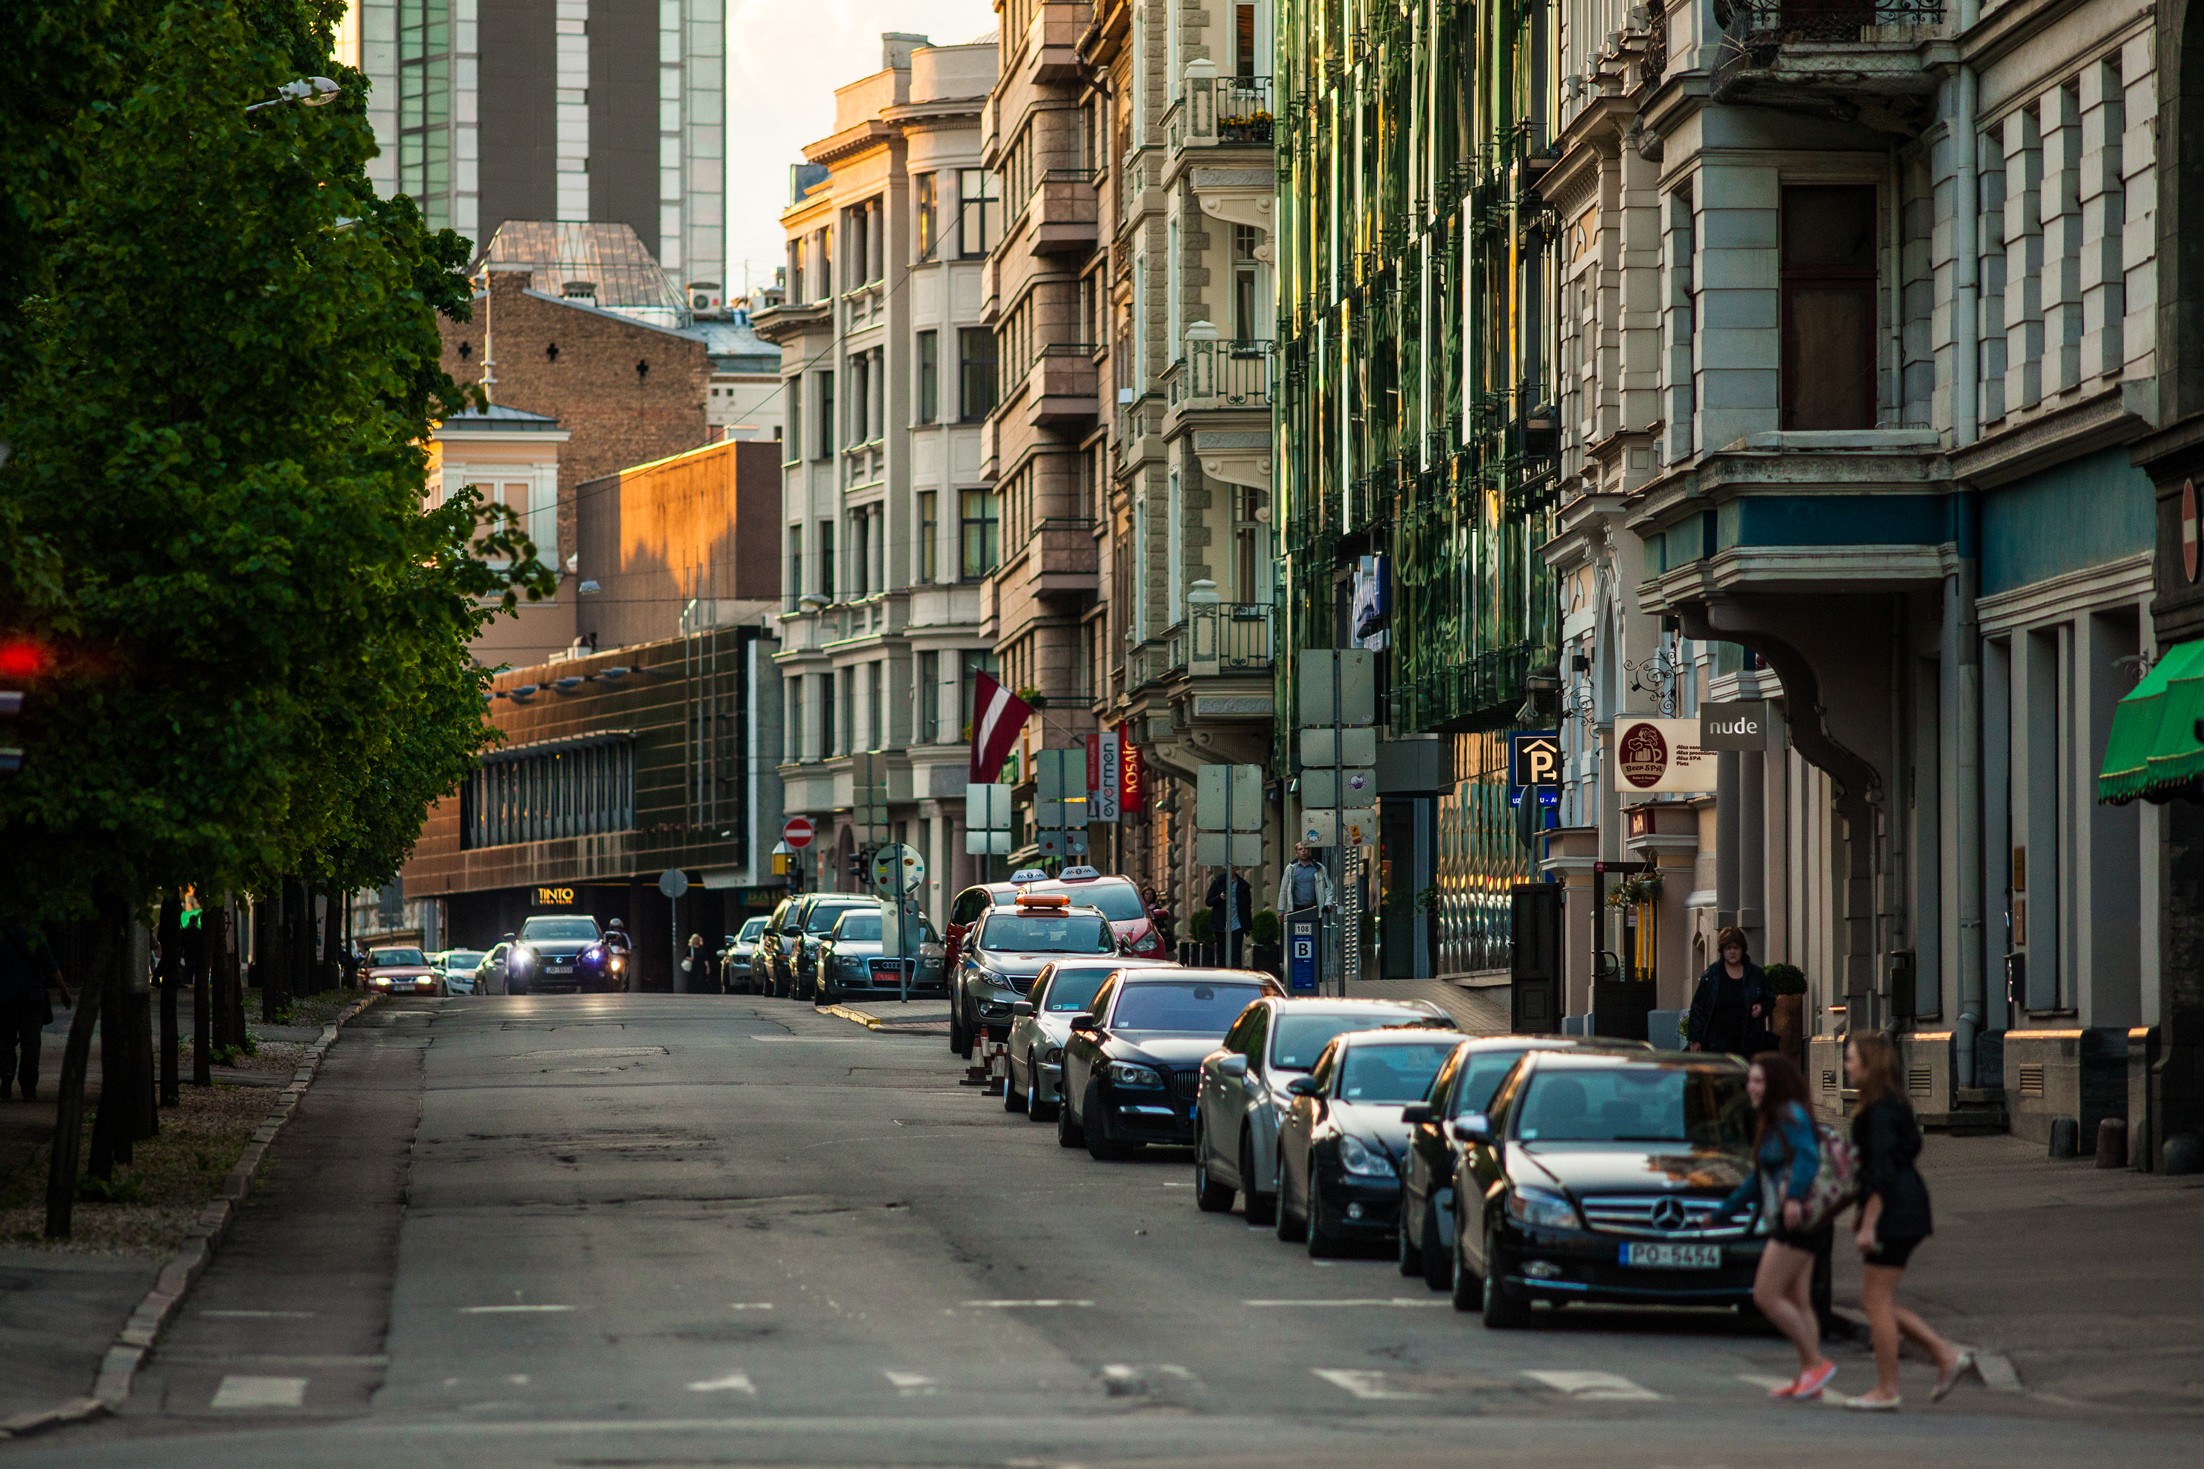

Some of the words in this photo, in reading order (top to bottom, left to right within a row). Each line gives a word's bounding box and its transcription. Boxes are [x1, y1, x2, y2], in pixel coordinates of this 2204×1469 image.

[1709, 716, 1758, 734] nude
[1530, 750, 1553, 783] P
[1626, 764, 1644, 773] Beer
[1645, 763, 1663, 772] SPA
[1103, 743, 1114, 817] evermen
[537, 887, 574, 900] TINTO
[1296, 925, 1309, 933] 108
[1298, 943, 1309, 957] B
